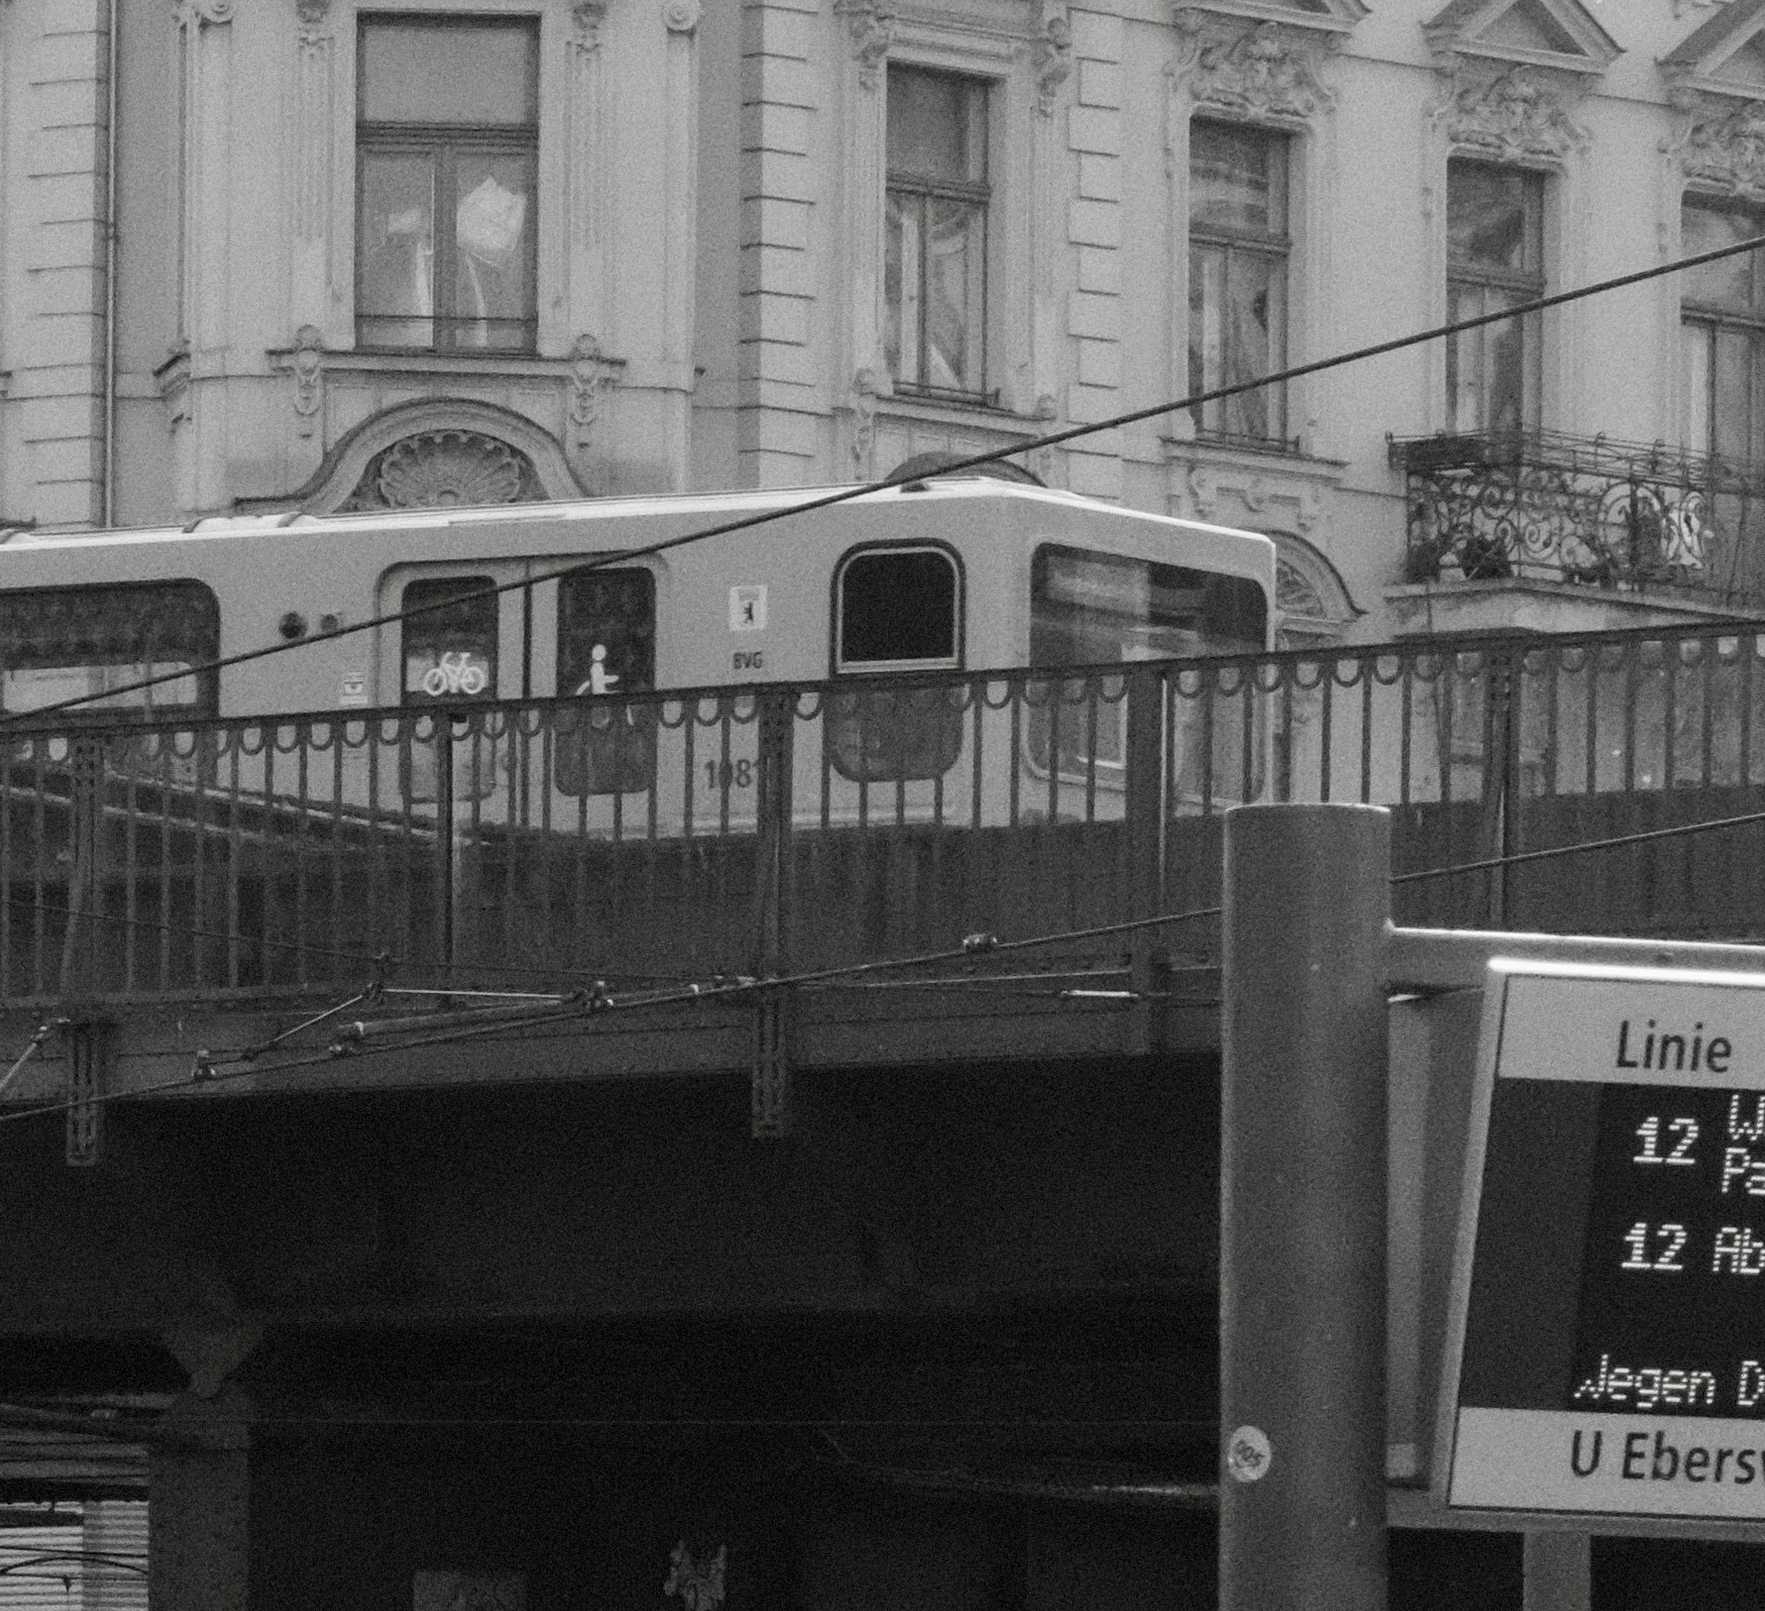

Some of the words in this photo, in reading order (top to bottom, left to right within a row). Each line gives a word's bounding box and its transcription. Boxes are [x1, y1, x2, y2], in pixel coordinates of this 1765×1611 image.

[1615, 1018, 1732, 1074] Linie
[1633, 1117, 1699, 1166] 12
[1620, 1222, 1687, 1271] 12
[1570, 1429, 1603, 1479] U
[1621, 1430, 1765, 1485] Ebers
